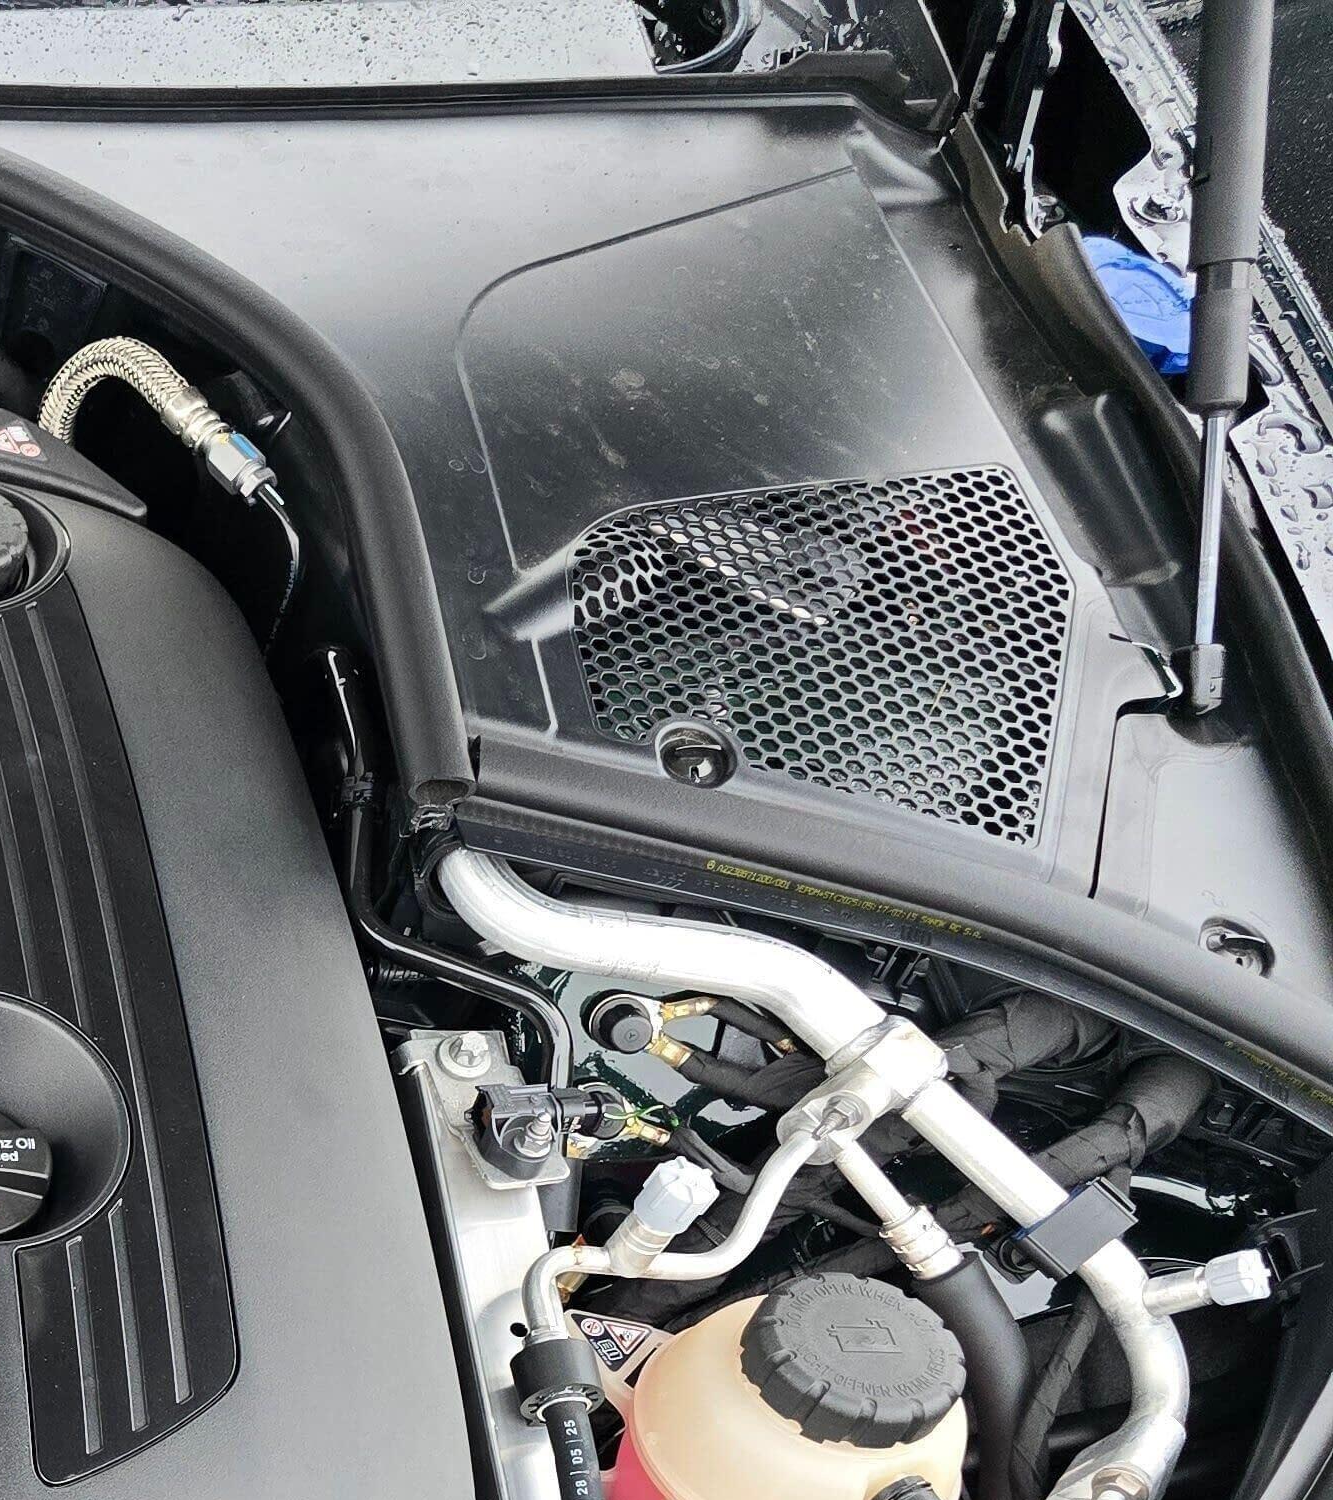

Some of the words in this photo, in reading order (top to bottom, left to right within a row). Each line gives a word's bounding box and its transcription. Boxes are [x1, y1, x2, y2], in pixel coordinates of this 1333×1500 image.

[15, 1138, 36, 1150] Oil
[563, 1419, 578, 1436] 25
[569, 1448, 584, 1465] 05
[576, 1479, 589, 1496] 28
